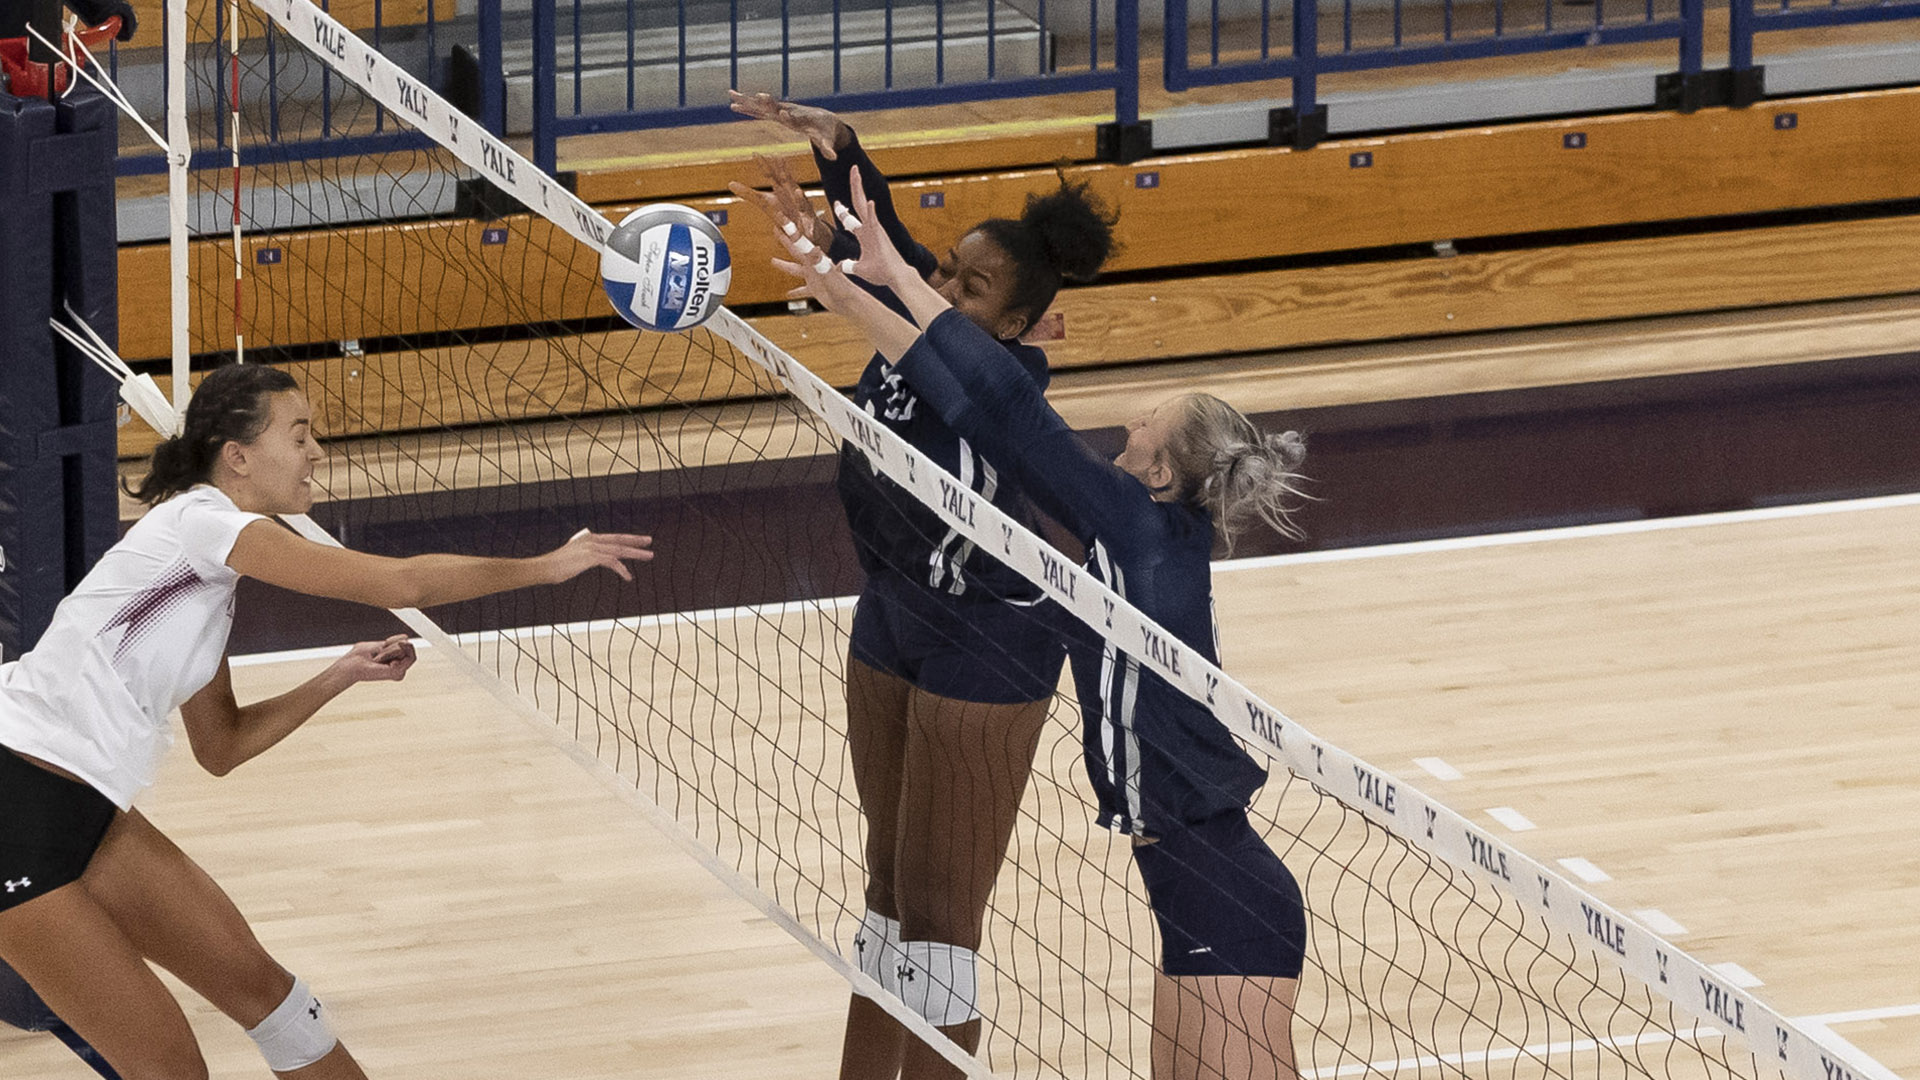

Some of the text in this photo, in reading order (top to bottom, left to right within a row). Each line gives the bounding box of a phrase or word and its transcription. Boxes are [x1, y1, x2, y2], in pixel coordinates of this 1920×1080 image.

[314, 15, 346, 61] YALE
[396, 76, 428, 121] YALE
[480, 137, 516, 185] YALE
[686, 246, 710, 317] molten
[846, 411, 884, 460] YALE
[939, 478, 976, 530] YALE
[1039, 548, 1077, 602] YALE
[1140, 624, 1182, 677] YALE
[1246, 699, 1283, 750] YALE
[1353, 764, 1396, 816] YALE
[1465, 831, 1511, 883] YALE
[1581, 901, 1626, 956] YALE
[1700, 977, 1746, 1032] YALE
